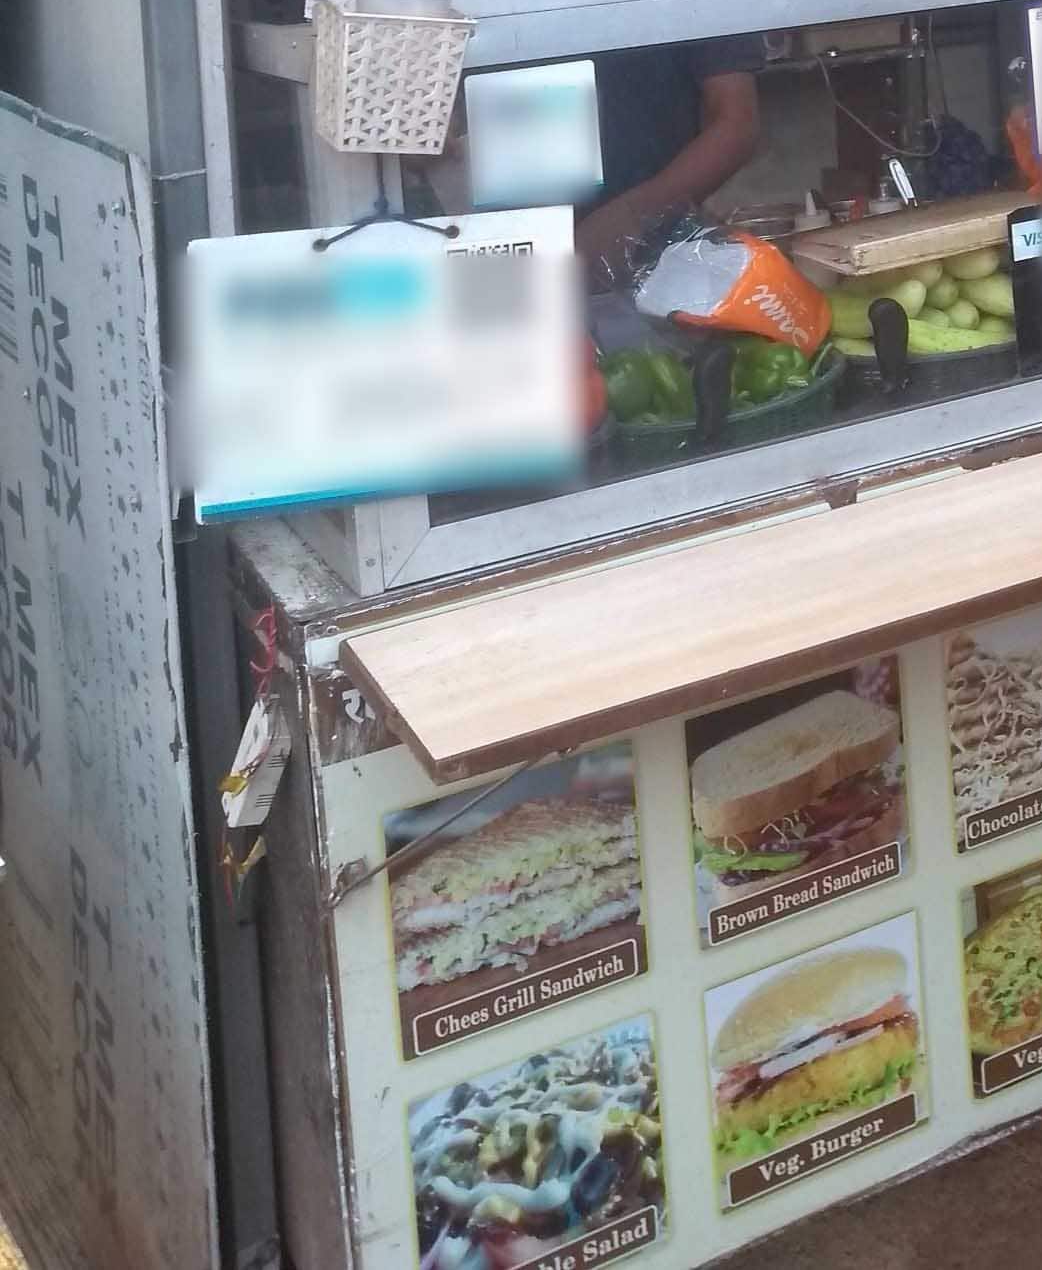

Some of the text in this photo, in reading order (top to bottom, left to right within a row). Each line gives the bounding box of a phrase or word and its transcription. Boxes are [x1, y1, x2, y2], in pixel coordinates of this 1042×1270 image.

[22, 172, 62, 518] DECOR
[716, 854, 895, 936] Brown Bread Sandwich
[434, 954, 626, 1039] Chees Grill Sandwich
[758, 1117, 884, 1182] Veg. Burger
[582, 1216, 650, 1265] Salad
